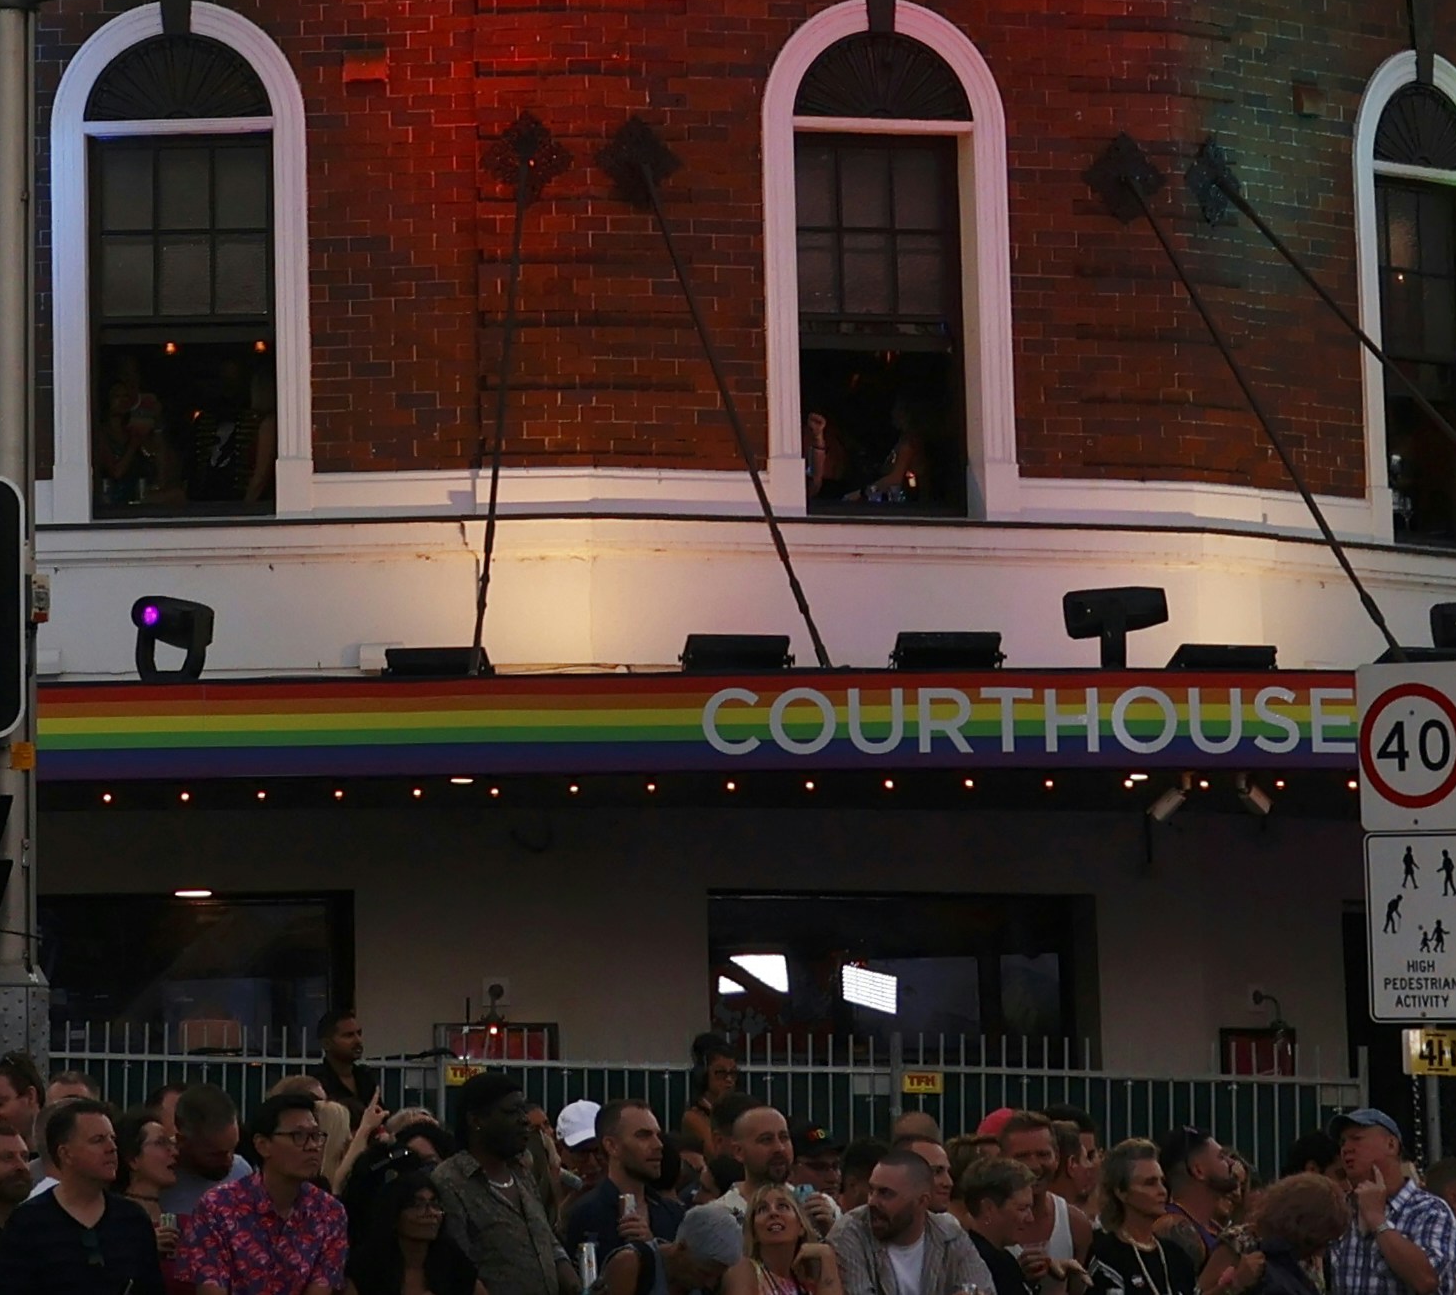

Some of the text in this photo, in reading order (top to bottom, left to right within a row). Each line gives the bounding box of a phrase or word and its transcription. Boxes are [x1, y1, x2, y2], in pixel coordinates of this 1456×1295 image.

[701, 684, 1356, 756] COURTHOUSE
[1376, 717, 1452, 773] 40
[1407, 959, 1436, 973] HIGH
[1395, 994, 1451, 1009] ACTIVITY
[907, 1074, 935, 1087] TFH
